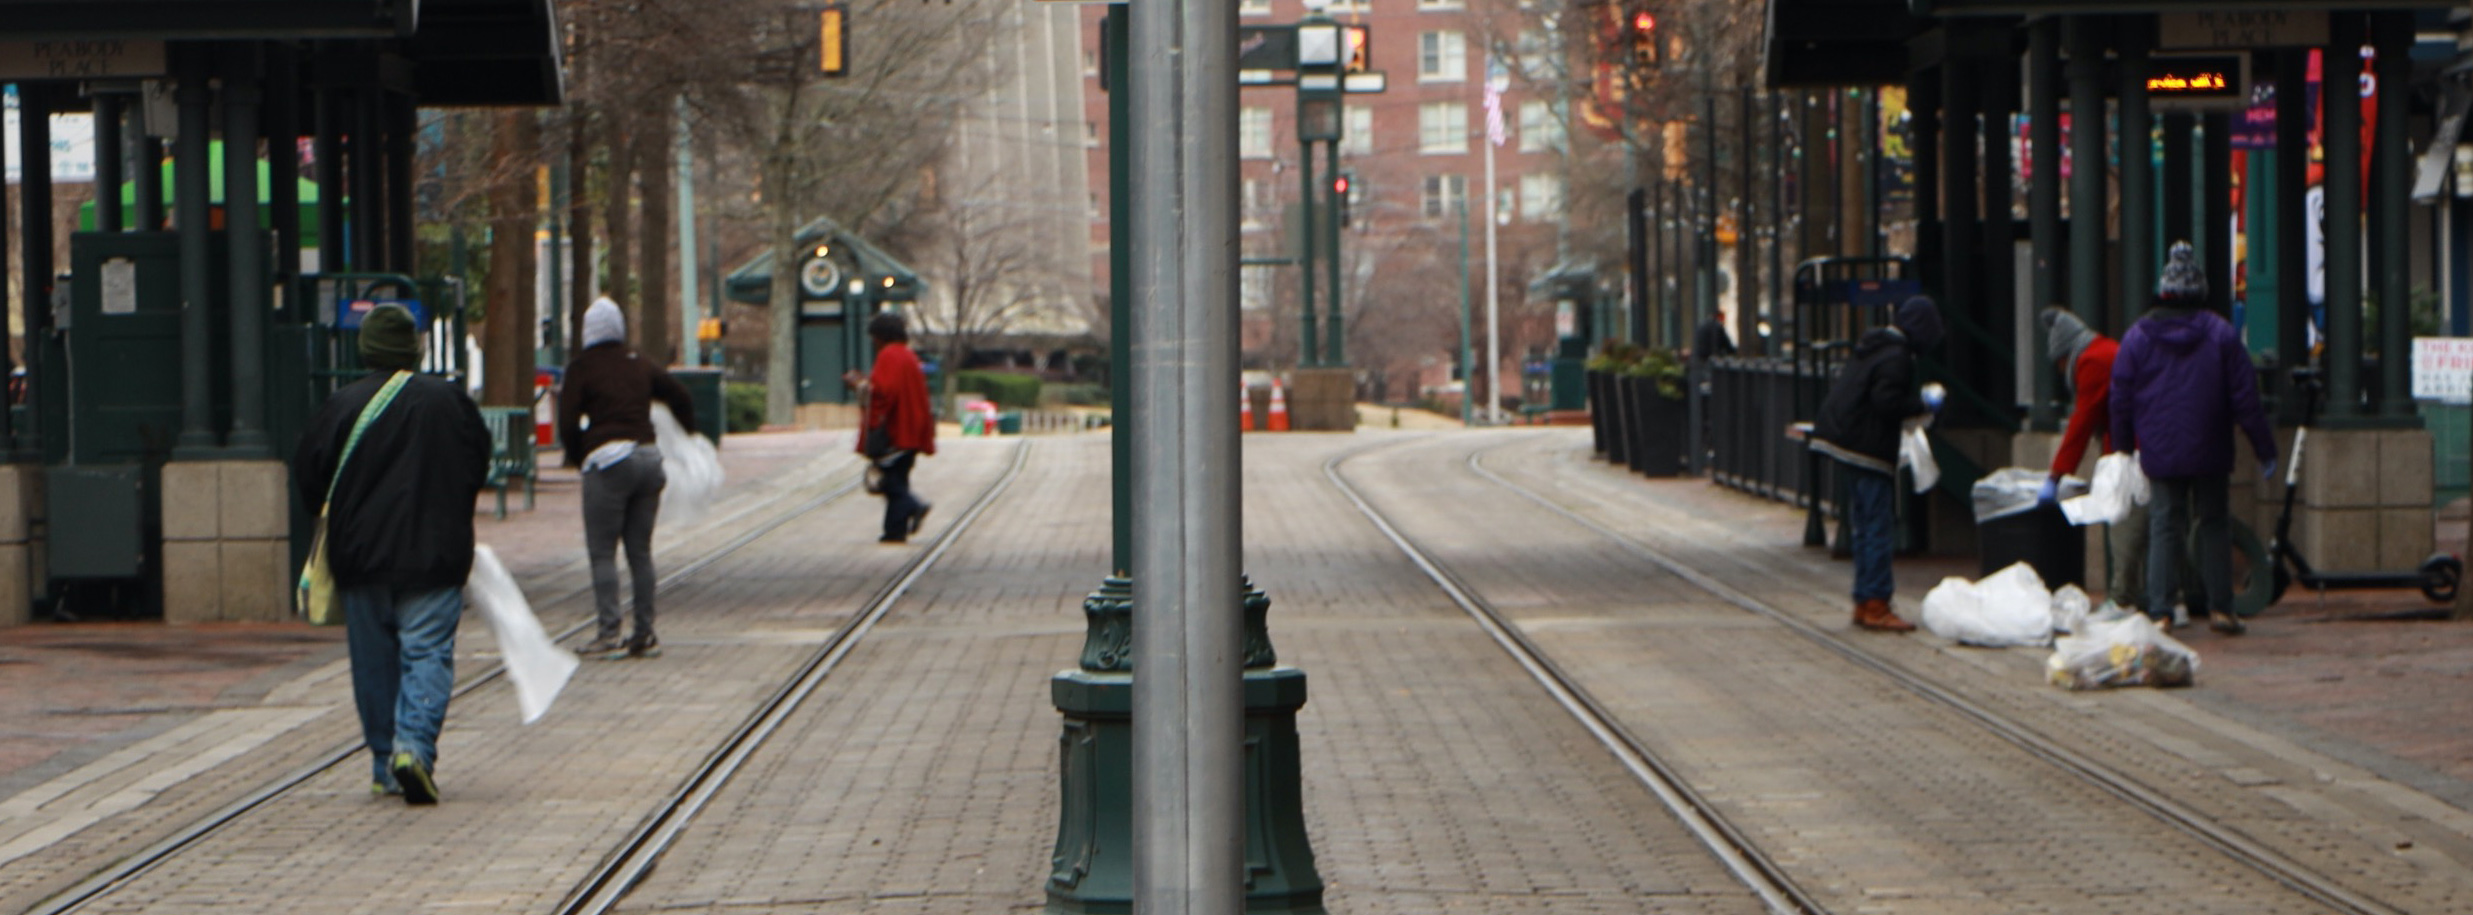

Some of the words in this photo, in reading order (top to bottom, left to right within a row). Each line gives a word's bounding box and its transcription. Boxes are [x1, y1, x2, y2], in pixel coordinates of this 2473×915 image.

[2196, 10, 2289, 27] PEABODY
[2212, 29, 2275, 45] PLACE
[34, 40, 126, 58] PEABODY
[50, 58, 109, 76] PLACE
